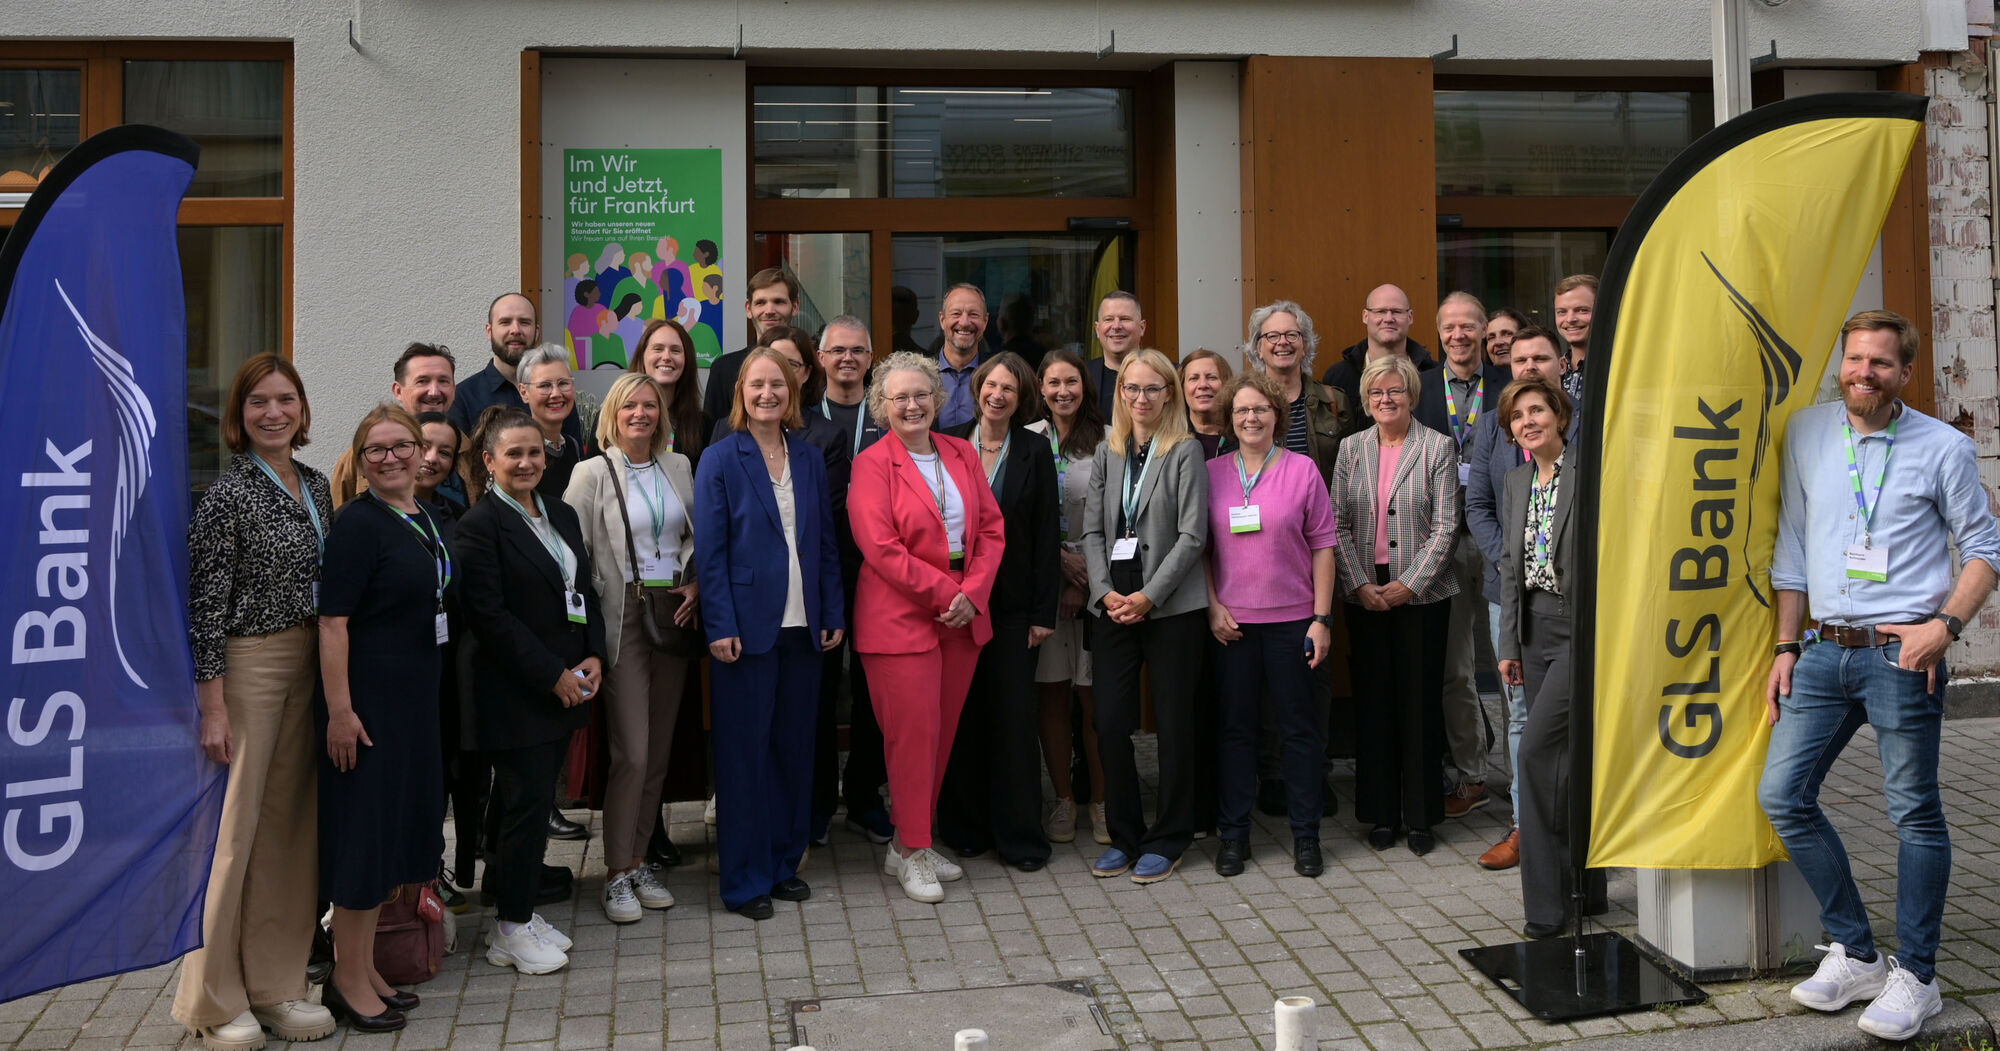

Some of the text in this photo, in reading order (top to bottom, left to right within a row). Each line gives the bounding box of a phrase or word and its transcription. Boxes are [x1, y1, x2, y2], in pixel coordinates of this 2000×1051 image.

[570, 155, 637, 172] Im Wir
[570, 175, 668, 197] und Jetzt,
[569, 196, 696, 214] für Frankfurt
[1658, 396, 1743, 759] GLS Bank
[3, 437, 93, 871] GLS Bank
